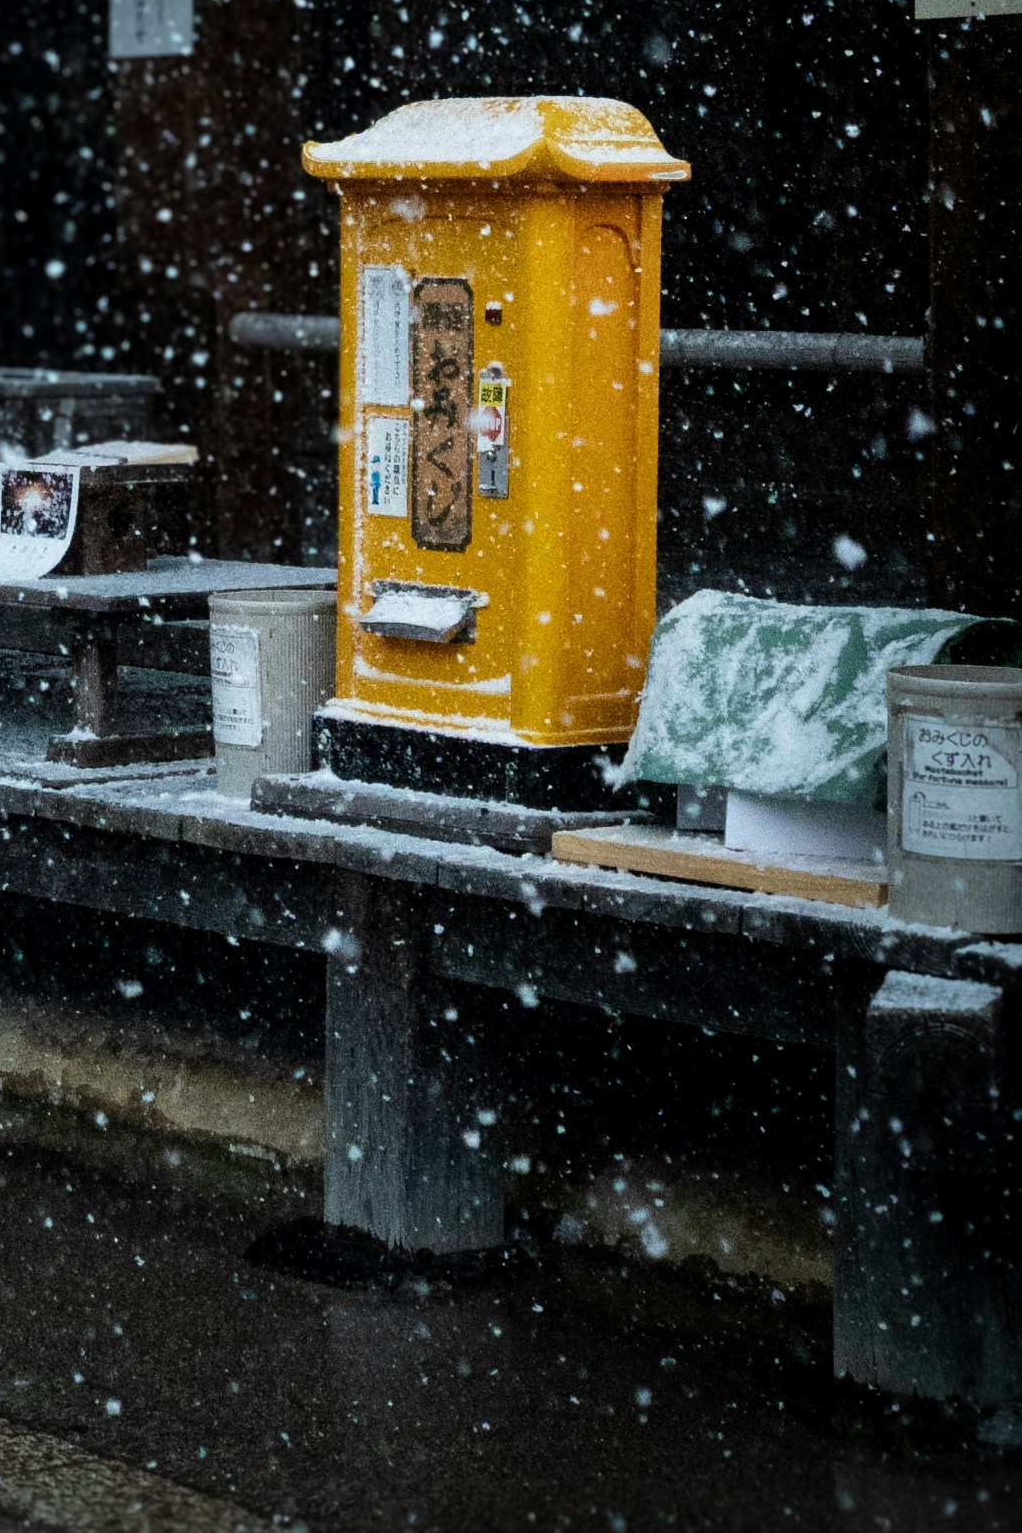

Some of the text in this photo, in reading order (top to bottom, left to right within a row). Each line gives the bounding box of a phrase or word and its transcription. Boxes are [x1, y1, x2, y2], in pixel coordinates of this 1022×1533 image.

[919, 728, 988, 747] おみくじの
[931, 751, 992, 768] くず入れ
